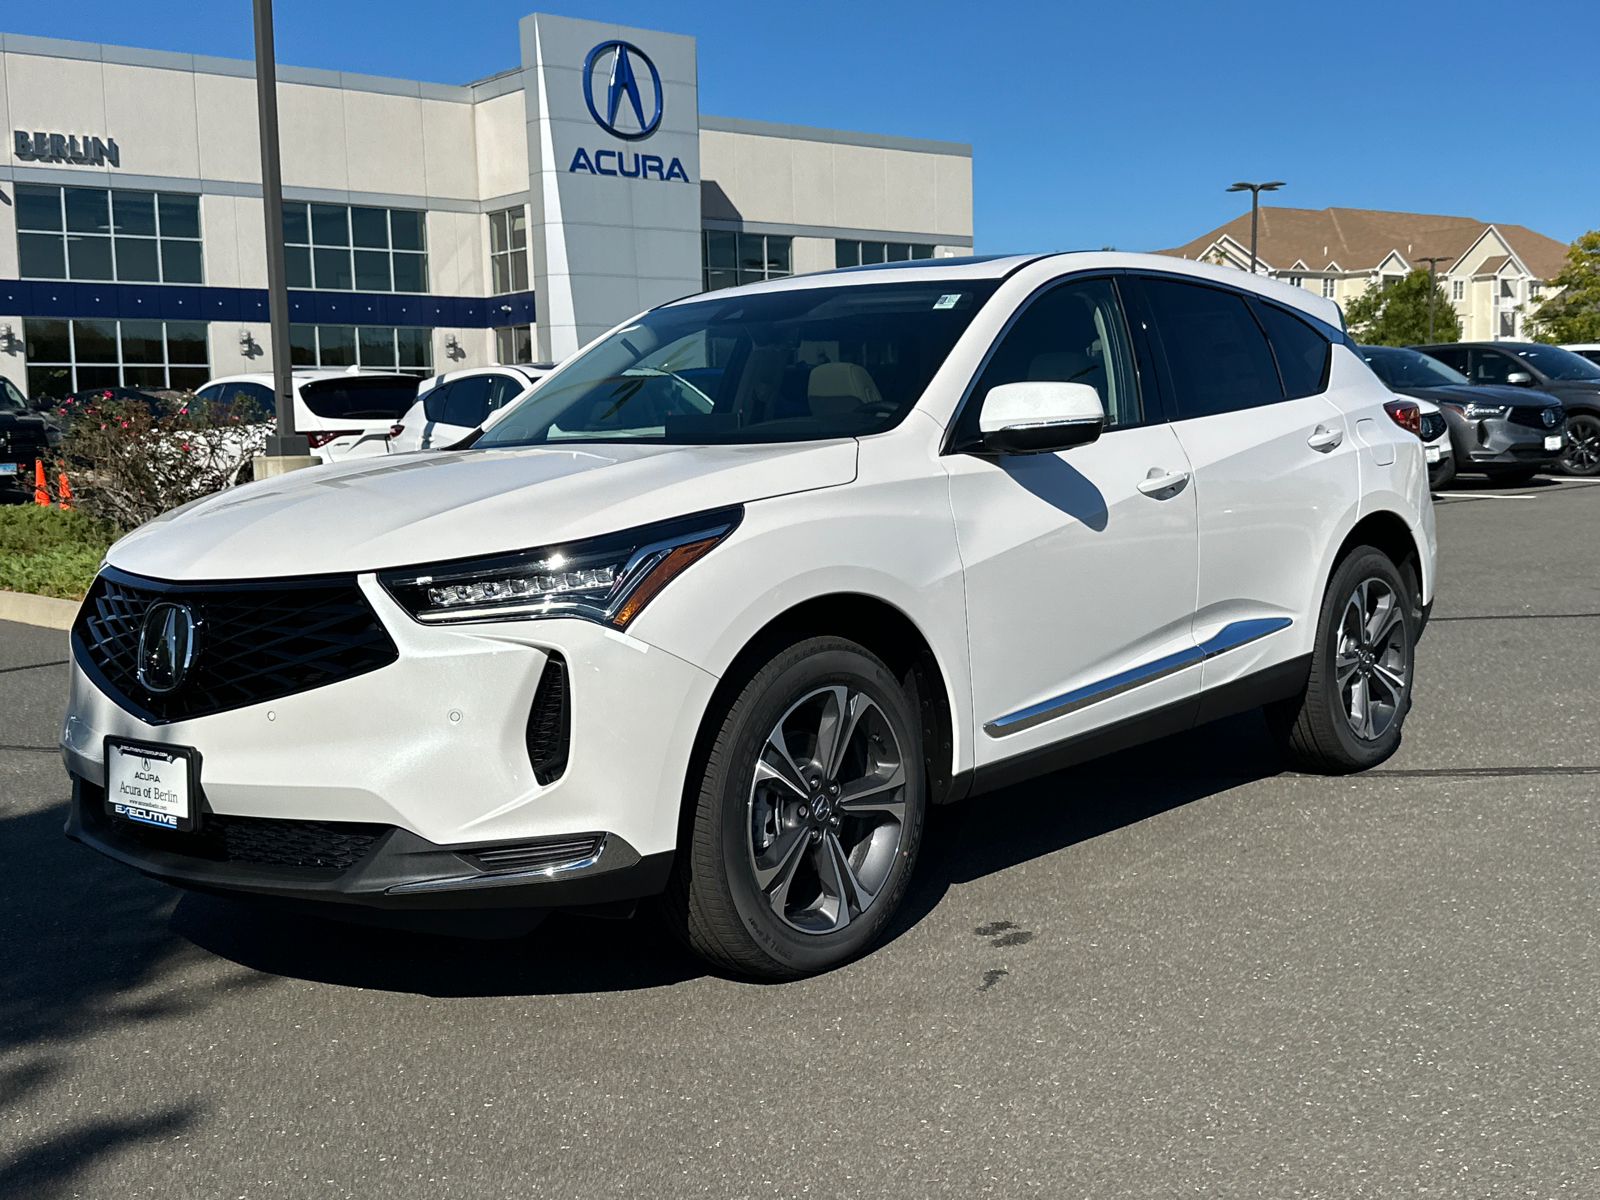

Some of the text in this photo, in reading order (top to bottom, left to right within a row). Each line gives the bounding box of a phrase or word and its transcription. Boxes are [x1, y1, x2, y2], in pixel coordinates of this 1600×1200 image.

[14, 130, 120, 168] BERLIN
[569, 147, 690, 183] ACURA
[135, 771, 161, 783] ACURA
[120, 781, 178, 803] Acura of Berlin
[115, 805, 177, 825] EXECUTIVE
